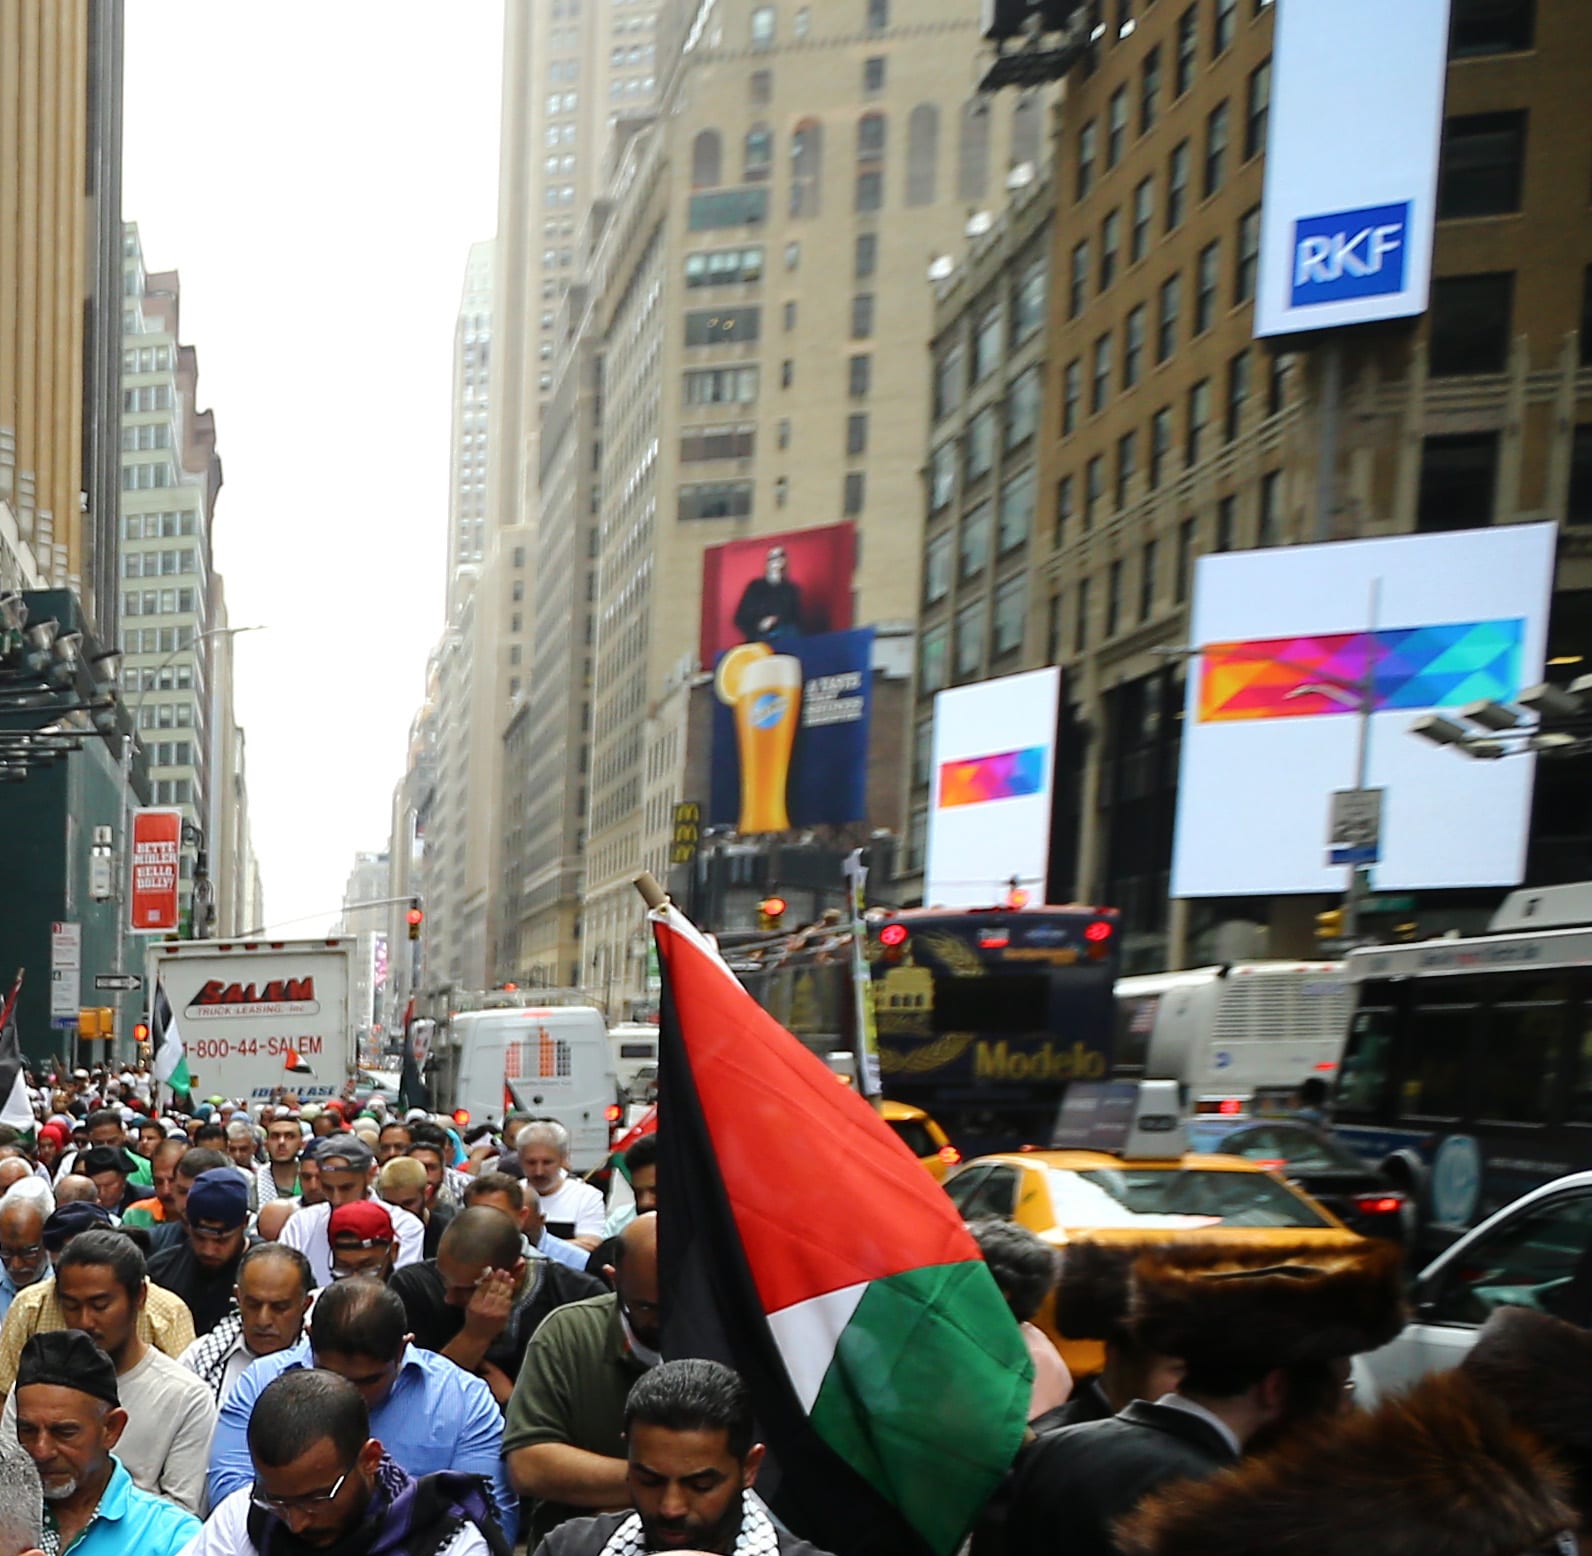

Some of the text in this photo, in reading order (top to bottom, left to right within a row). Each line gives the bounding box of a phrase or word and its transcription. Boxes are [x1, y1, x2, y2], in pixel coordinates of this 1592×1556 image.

[1294, 223, 1404, 288] RKF
[191, 976, 315, 1005] SALEM
[198, 1006, 232, 1016] TRUCK
[183, 1035, 323, 1059] 1-800-44-SALEM
[975, 1039, 1107, 1079] Modelo
